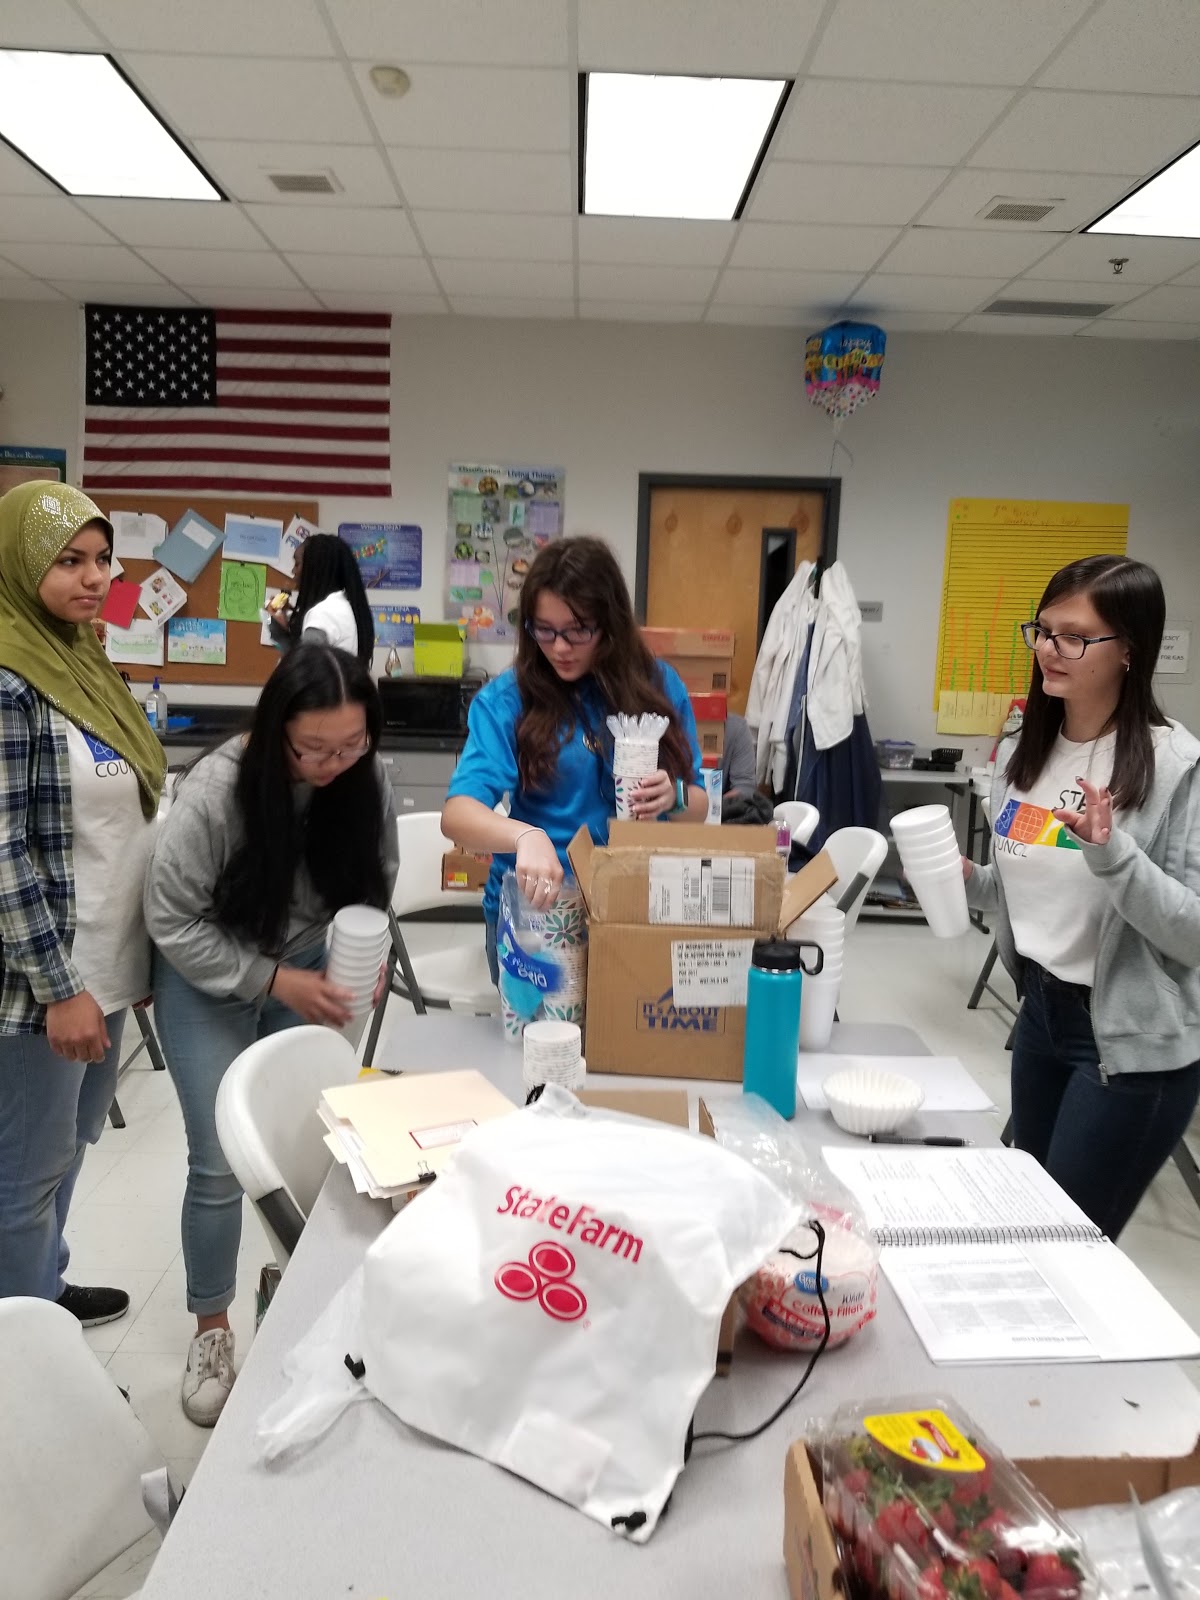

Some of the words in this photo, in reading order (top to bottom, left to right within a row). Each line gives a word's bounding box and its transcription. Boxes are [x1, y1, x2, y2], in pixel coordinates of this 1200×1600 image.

[95, 760, 132, 778] COU
[648, 1016, 717, 1031] TIME
[836, 1303, 864, 1318] Filters
